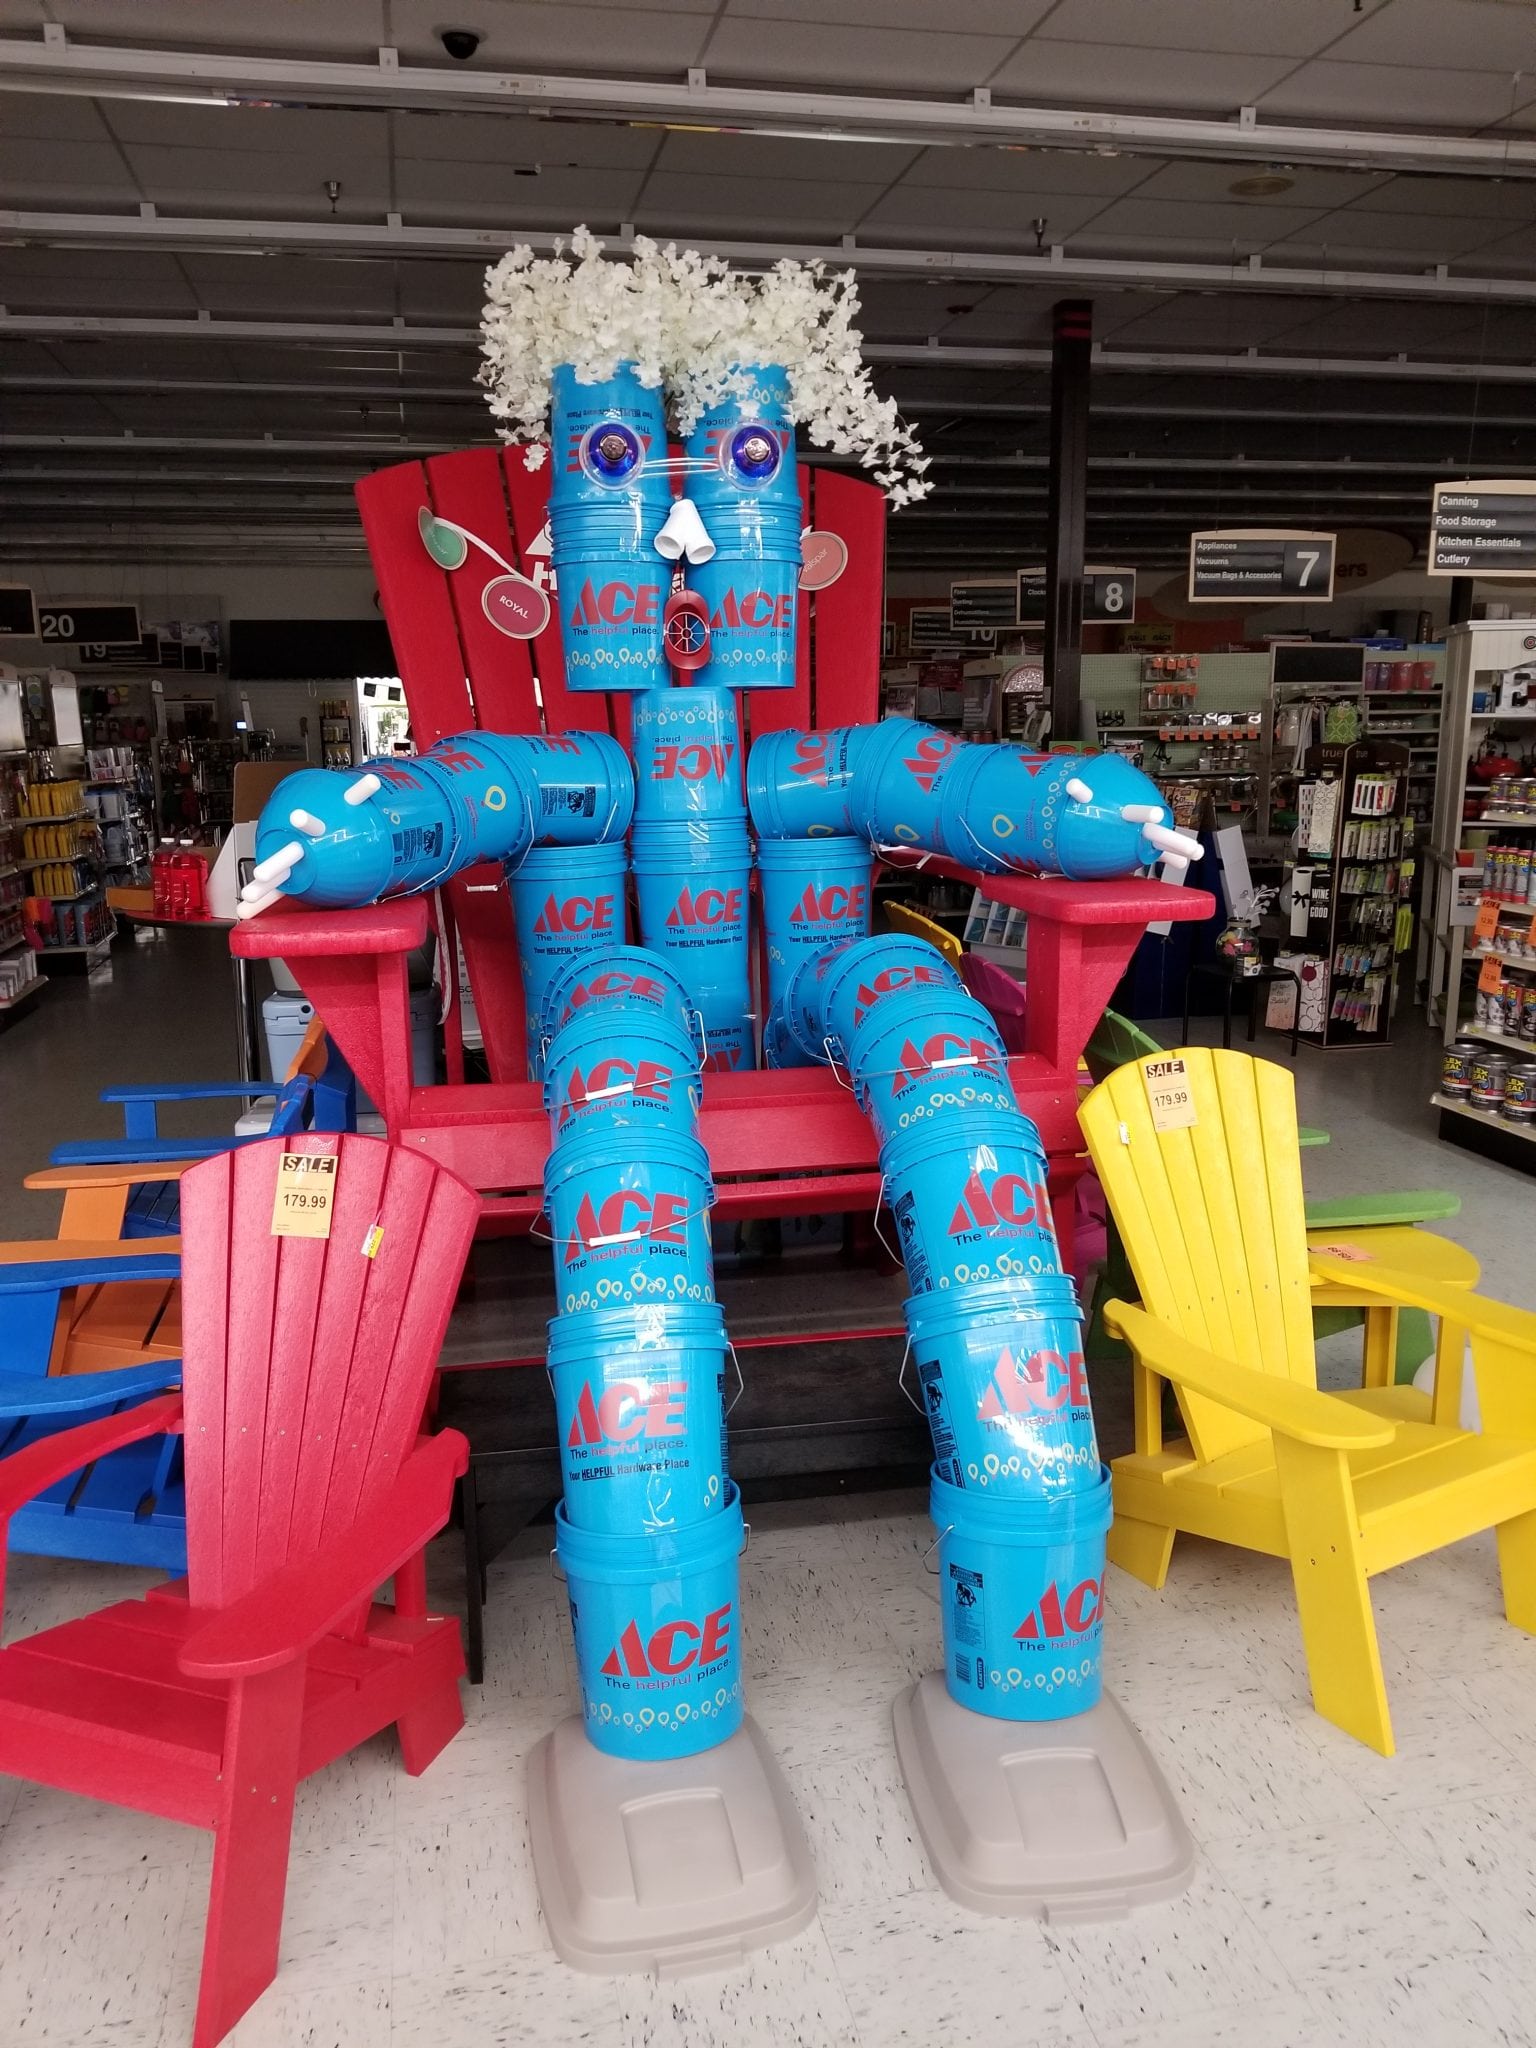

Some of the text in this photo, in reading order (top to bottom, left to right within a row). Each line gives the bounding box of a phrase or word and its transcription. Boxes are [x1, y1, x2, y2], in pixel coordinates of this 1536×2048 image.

[1440, 496, 1479, 508] Canning
[1435, 516, 1497, 528] Food Storage
[1197, 542, 1237, 551] Appliances
[1438, 536, 1521, 547] Kitchen Essentials
[1196, 557, 1229, 565] Vacuums
[1296, 551, 1320, 587] 7
[1437, 553, 1471, 566] Cutlery
[1222, 571, 1238, 581] Bags
[1245, 571, 1282, 579] Accessories
[499, 595, 529, 620] ROYAL
[570, 576, 661, 627] ACE
[710, 587, 794, 629] ACE
[1105, 582, 1123, 612] 8
[41, 614, 74, 638] 20
[573, 628, 588, 636] The
[711, 630, 728, 638] The
[83, 645, 107, 658] 19
[651, 743, 735, 784] ACE
[1322, 749, 1344, 758] true
[931, 775, 944, 793] The
[664, 885, 743, 926] ACE
[789, 880, 866, 922] ACE
[1312, 889, 1330, 899] WINE
[533, 892, 615, 932] ACE
[1310, 907, 1328, 918] GOOD
[560, 972, 669, 1027] ACE
[854, 965, 945, 1031] ACE
[891, 1033, 1001, 1098] ACE
[1148, 1062, 1181, 1078] SALE
[558, 1058, 674, 1131] ACE
[895, 1084, 917, 1101] The
[919, 1070, 968, 1085] helpful
[1155, 1092, 1188, 1107] 179.99
[558, 1098, 673, 1136] The helpful place.
[284, 1156, 331, 1173] SALE
[284, 1194, 327, 1208] 179.99
[564, 1189, 689, 1265] ACE
[953, 1232, 983, 1246] The
[566, 1244, 690, 1275] The helpful place.
[976, 1345, 1089, 1421] ACE
[568, 1380, 689, 1448] ACE
[570, 1439, 688, 1461] The helpful place.
[569, 1459, 689, 1481] Your HELPFUL Hardware Place
[600, 1602, 732, 1678] ACE
[1017, 1631, 1094, 1652] The helpful
[603, 1659, 732, 1691] The helpful place.
